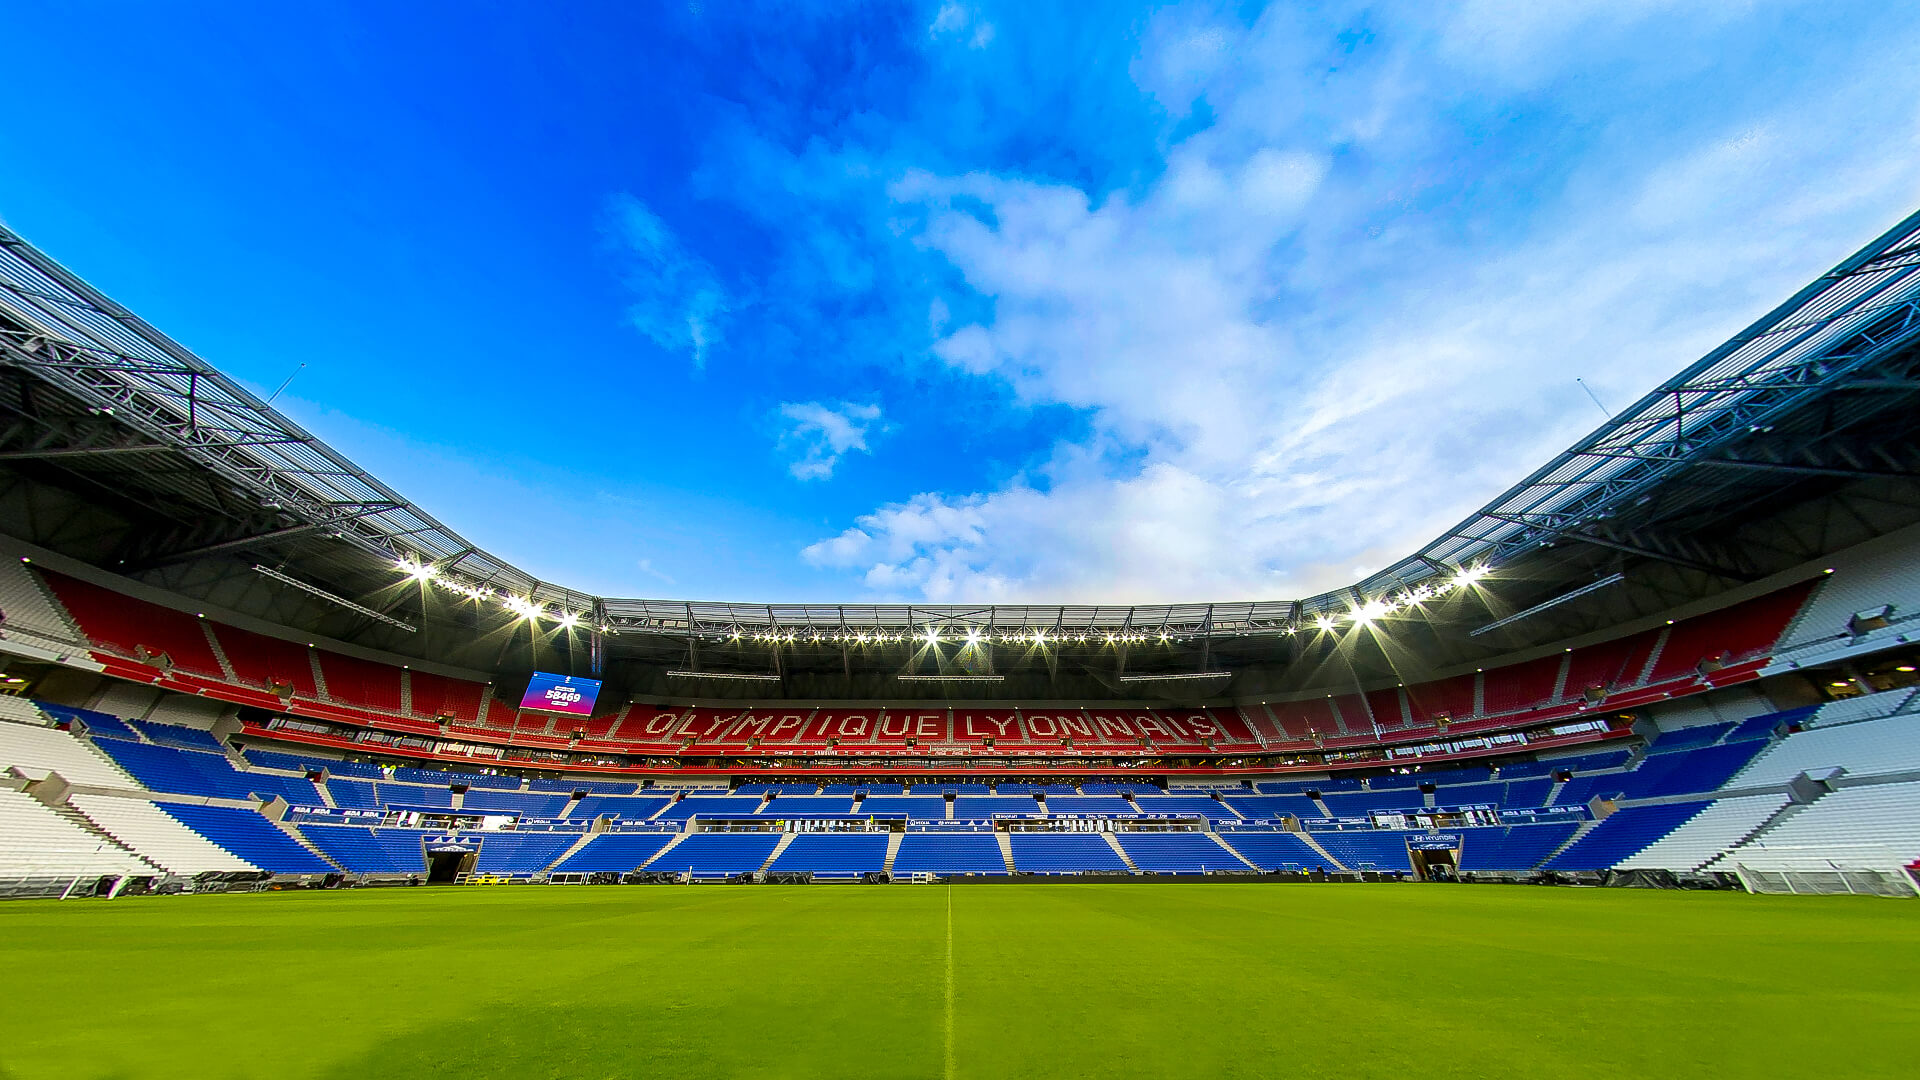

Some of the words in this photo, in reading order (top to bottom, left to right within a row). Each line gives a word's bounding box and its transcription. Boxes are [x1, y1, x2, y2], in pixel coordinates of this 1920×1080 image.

[545, 690, 581, 702] 58469
[645, 713, 939, 736] OLYMPIQUE
[966, 715, 1218, 736] LYONNAIS
